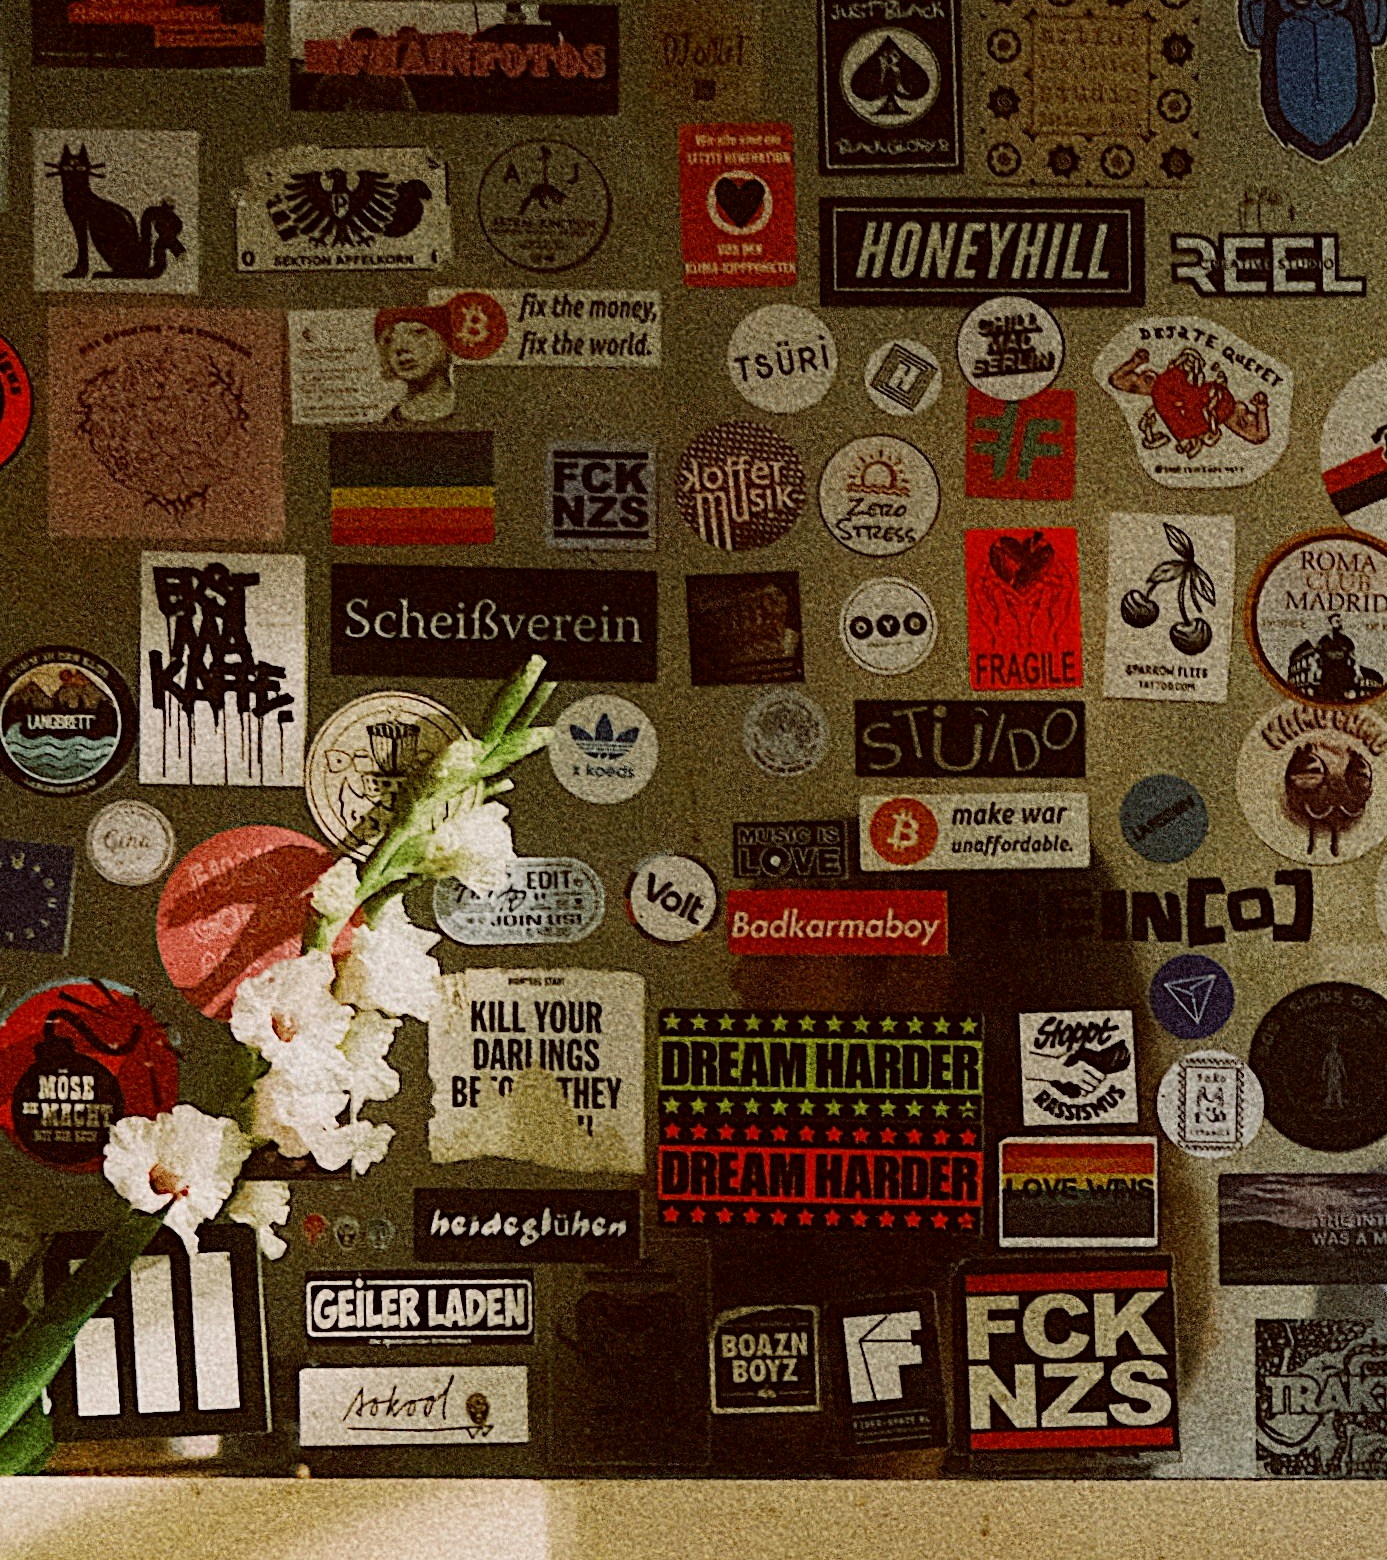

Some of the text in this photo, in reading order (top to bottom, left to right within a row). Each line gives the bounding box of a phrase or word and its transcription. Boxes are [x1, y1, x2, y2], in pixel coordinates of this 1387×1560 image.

[855, 222, 1111, 281] HONEYHILL
[519, 294, 657, 324] fix the money,
[519, 331, 652, 359] fix the world.
[554, 462, 648, 492] FCK
[555, 498, 649, 527] NZS
[1301, 552, 1377, 573] ROMA
[1305, 573, 1371, 591] CLUB
[344, 598, 643, 645] Scheißverein
[976, 652, 1075, 687] FRAGILE
[952, 804, 1067, 826] make war
[740, 847, 844, 876] LOVE
[951, 836, 1074, 856] unaffordable.
[527, 871, 572, 889] EDIT
[645, 873, 704, 924] Volt
[731, 909, 940, 944] Badkarmaboy
[471, 1001, 602, 1034] KILL YOUR
[1035, 1017, 1118, 1052] Stoppt
[663, 1042, 979, 1090] DREAM HARDER
[39, 1069, 94, 1100] MÖSE
[557, 1078, 621, 1109] THEY
[41, 1104, 113, 1127] MACHT
[1033, 1085, 1126, 1120] RASSISMUS
[663, 1151, 979, 1201] DREAM HARDER
[1005, 1179, 1153, 1199] LOVE WINS
[429, 1208, 627, 1246] heideglühen
[1311, 1231, 1350, 1245] WAS
[1355, 1231, 1370, 1245] A
[313, 1277, 525, 1328] GEILER LADEN
[966, 1291, 1169, 1360] FCK
[720, 1331, 809, 1358] BOAZN
[731, 1358, 799, 1384] BOYZ
[968, 1360, 1174, 1430] NZS
